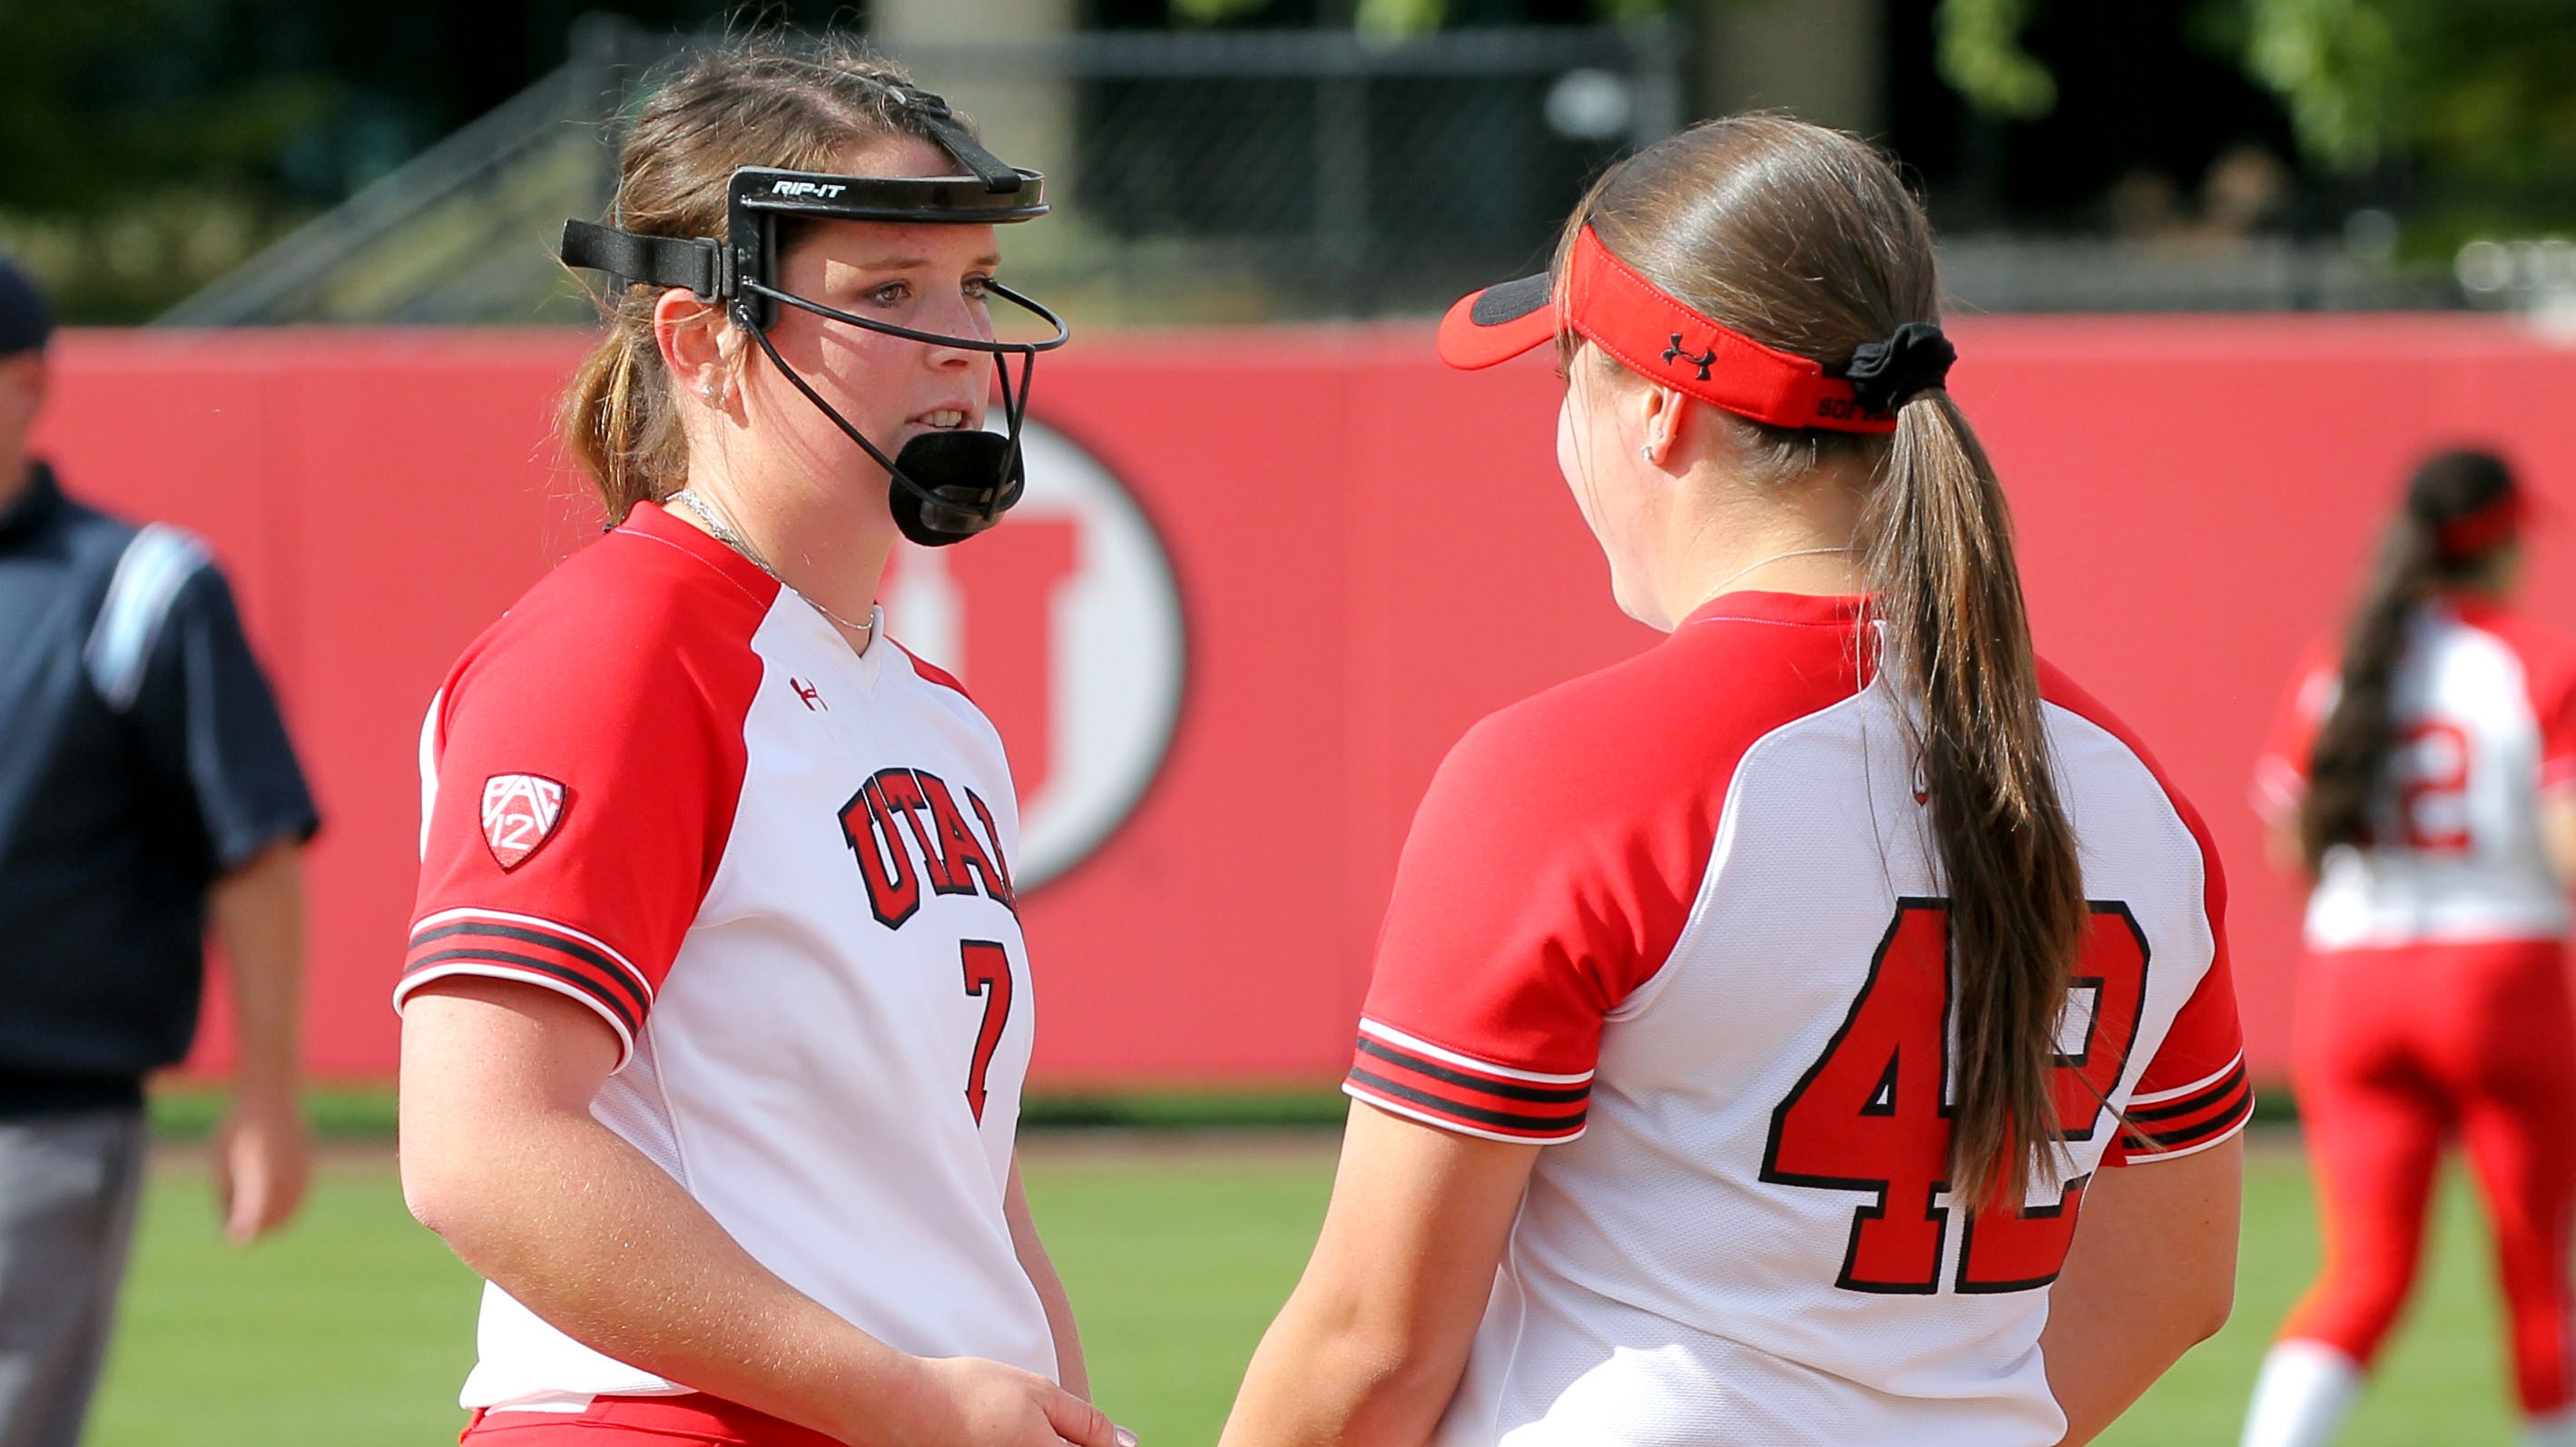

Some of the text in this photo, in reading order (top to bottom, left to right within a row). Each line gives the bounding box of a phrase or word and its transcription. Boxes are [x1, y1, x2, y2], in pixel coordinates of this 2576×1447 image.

[772, 181, 847, 198] RIP-IT
[481, 774, 562, 835] PAC
[491, 812, 531, 851] 12
[959, 939, 1013, 1131] 7
[1758, 896, 2151, 1295] 42
